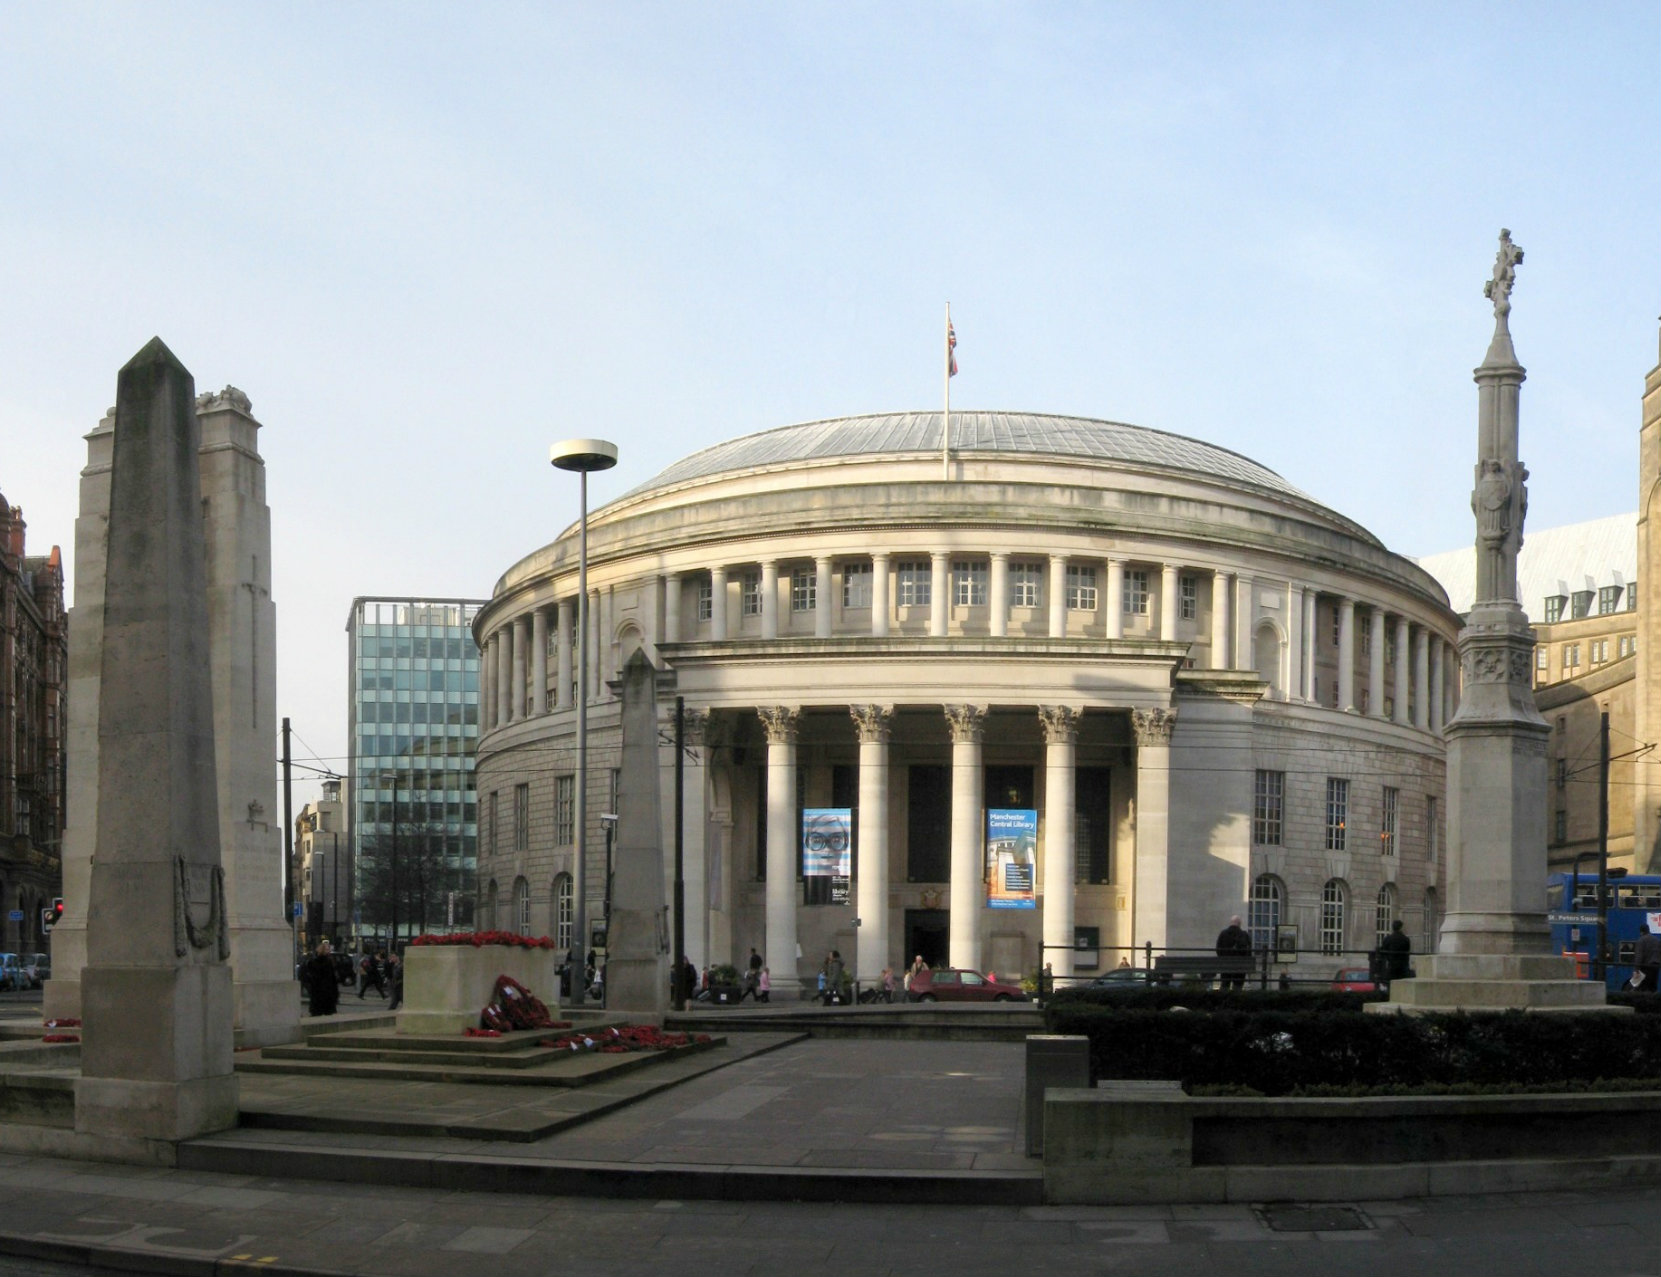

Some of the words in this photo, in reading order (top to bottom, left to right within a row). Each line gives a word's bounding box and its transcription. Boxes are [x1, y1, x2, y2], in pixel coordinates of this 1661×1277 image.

[990, 813, 1025, 821] Manchester
[990, 820, 1012, 828] Central
[1013, 820, 1034, 829] Library
